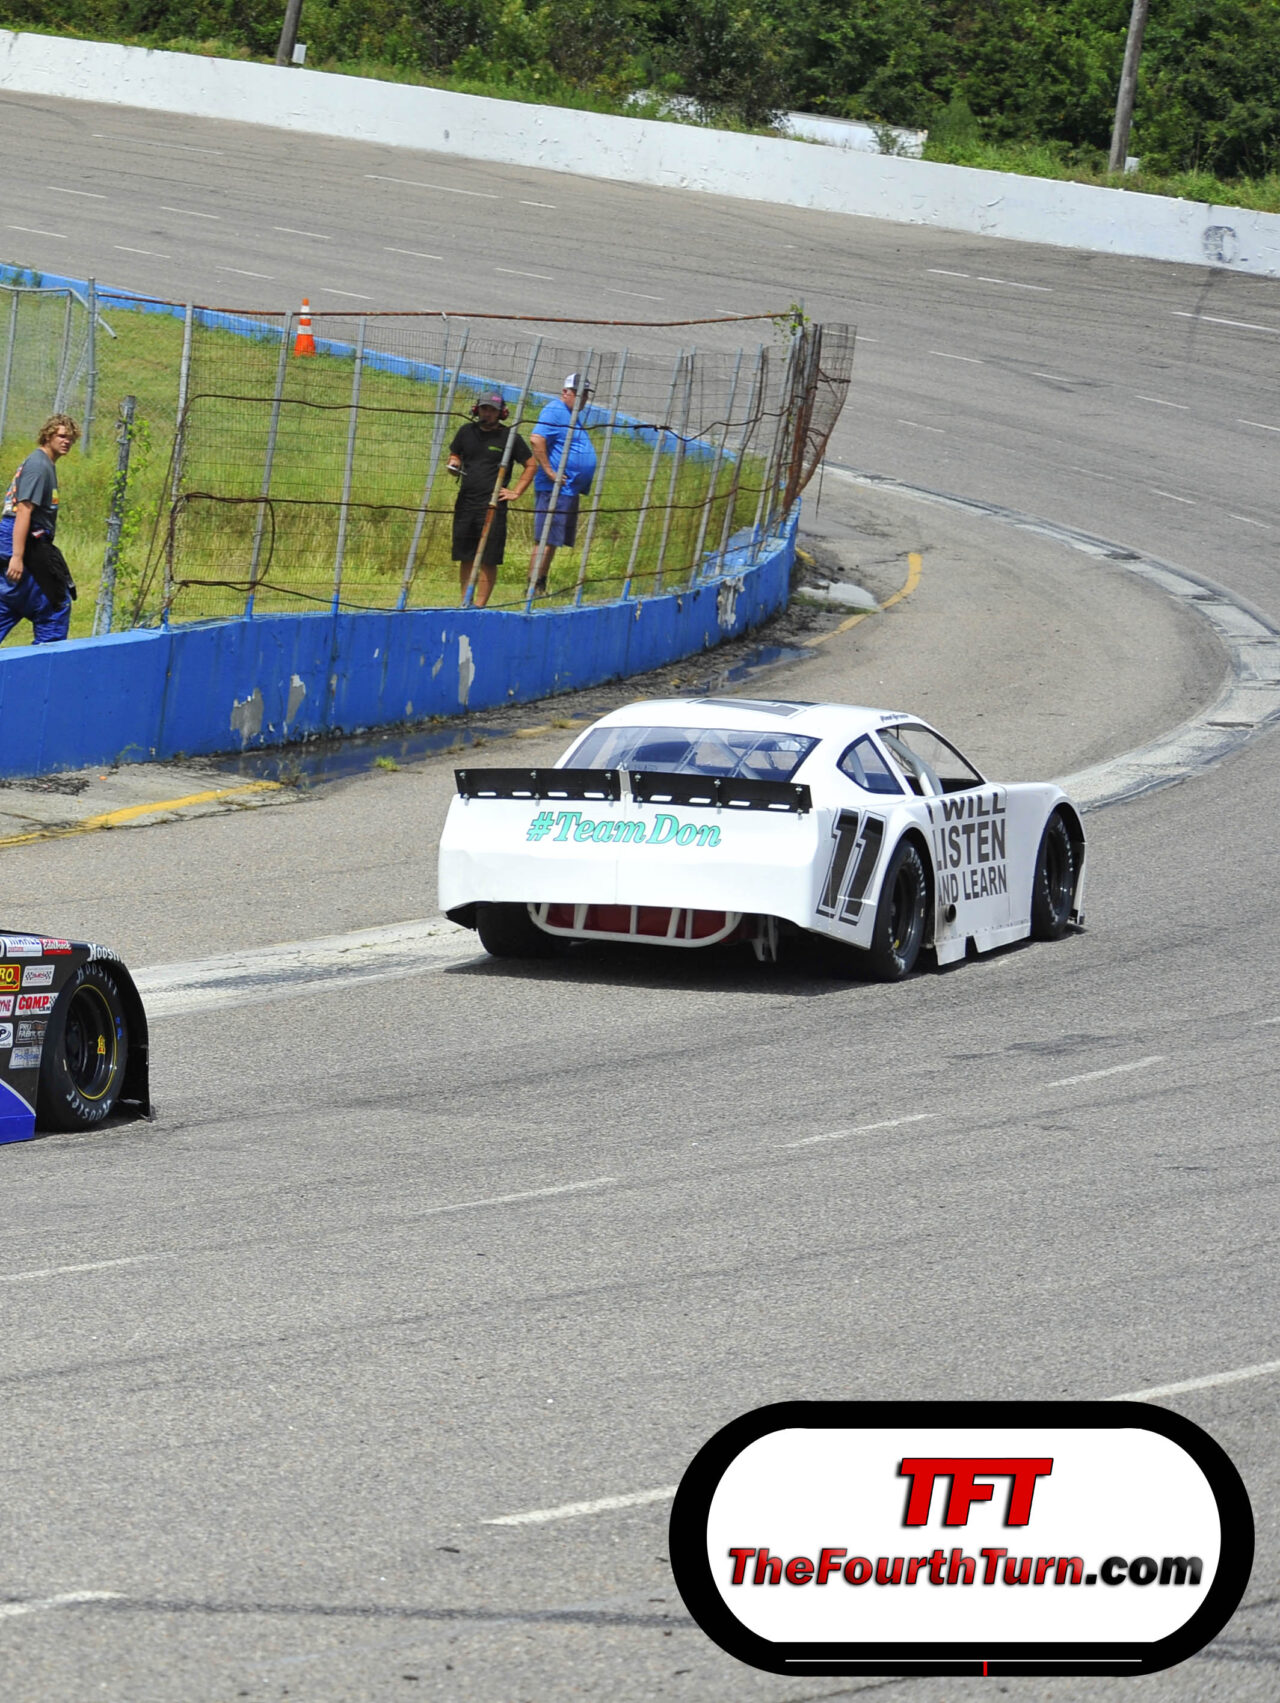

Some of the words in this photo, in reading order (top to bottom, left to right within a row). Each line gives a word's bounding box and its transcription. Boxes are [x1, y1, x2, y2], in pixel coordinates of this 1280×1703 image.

[939, 792, 1006, 822] WILL
[526, 811, 722, 847] #TeamDon
[932, 818, 1006, 872] LISTEN
[816, 807, 887, 926] 11
[962, 864, 1007, 901] LEARN
[18, 995, 50, 1010] COMP
